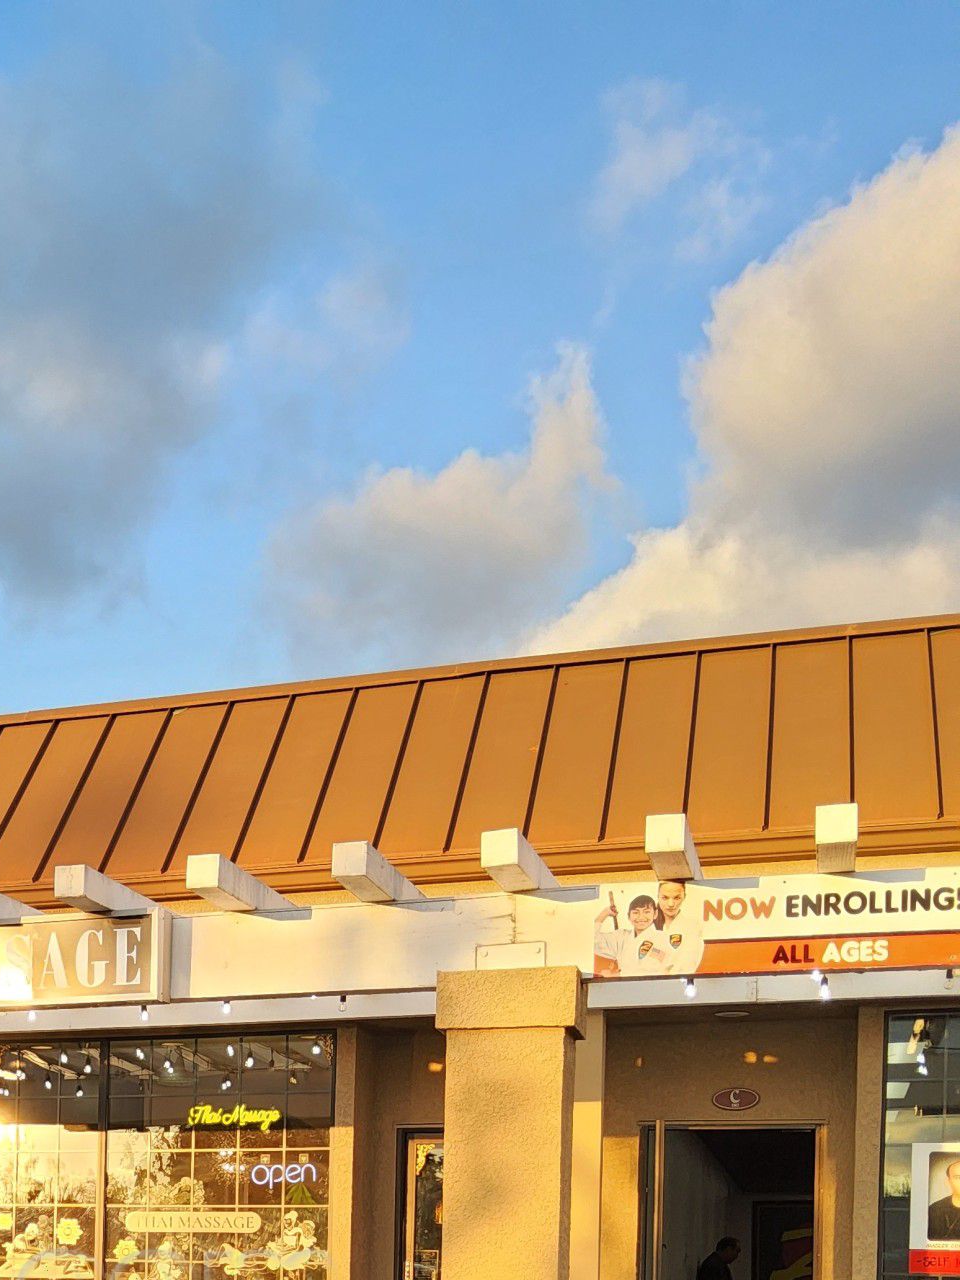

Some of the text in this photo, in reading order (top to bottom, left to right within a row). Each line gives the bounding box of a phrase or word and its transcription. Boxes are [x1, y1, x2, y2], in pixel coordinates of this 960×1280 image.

[703, 896, 776, 922] NOW
[772, 939, 889, 965] ALL AGES
[188, 1104, 281, 1130] Thai Massage
[177, 1215, 256, 1230] MASSAGE
